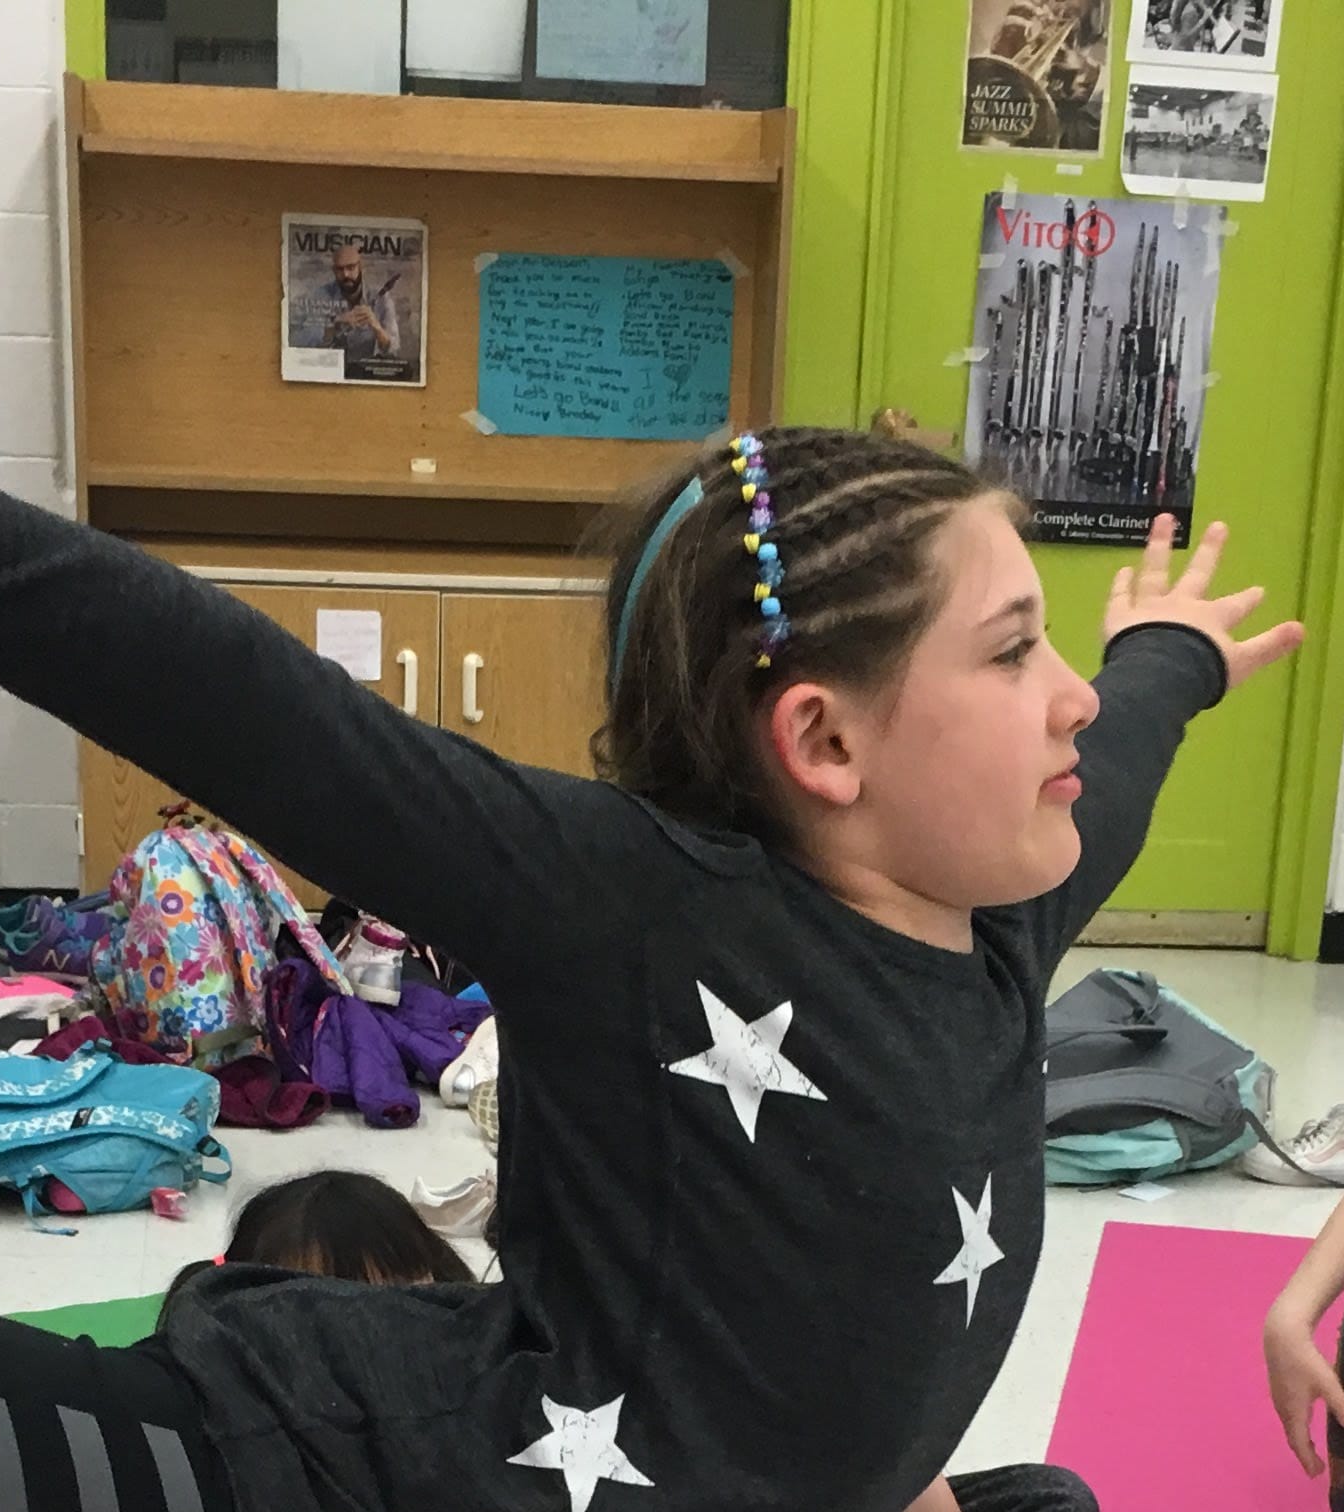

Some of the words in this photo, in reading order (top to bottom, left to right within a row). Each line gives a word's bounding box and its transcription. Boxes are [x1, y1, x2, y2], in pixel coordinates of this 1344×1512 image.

[971, 85, 1011, 99] JAZZ
[971, 100, 1039, 117] SUMMIT
[969, 116, 1030, 132] SPARKS
[1033, 511, 1096, 530] Complete
[1098, 513, 1150, 530] Clarinet
